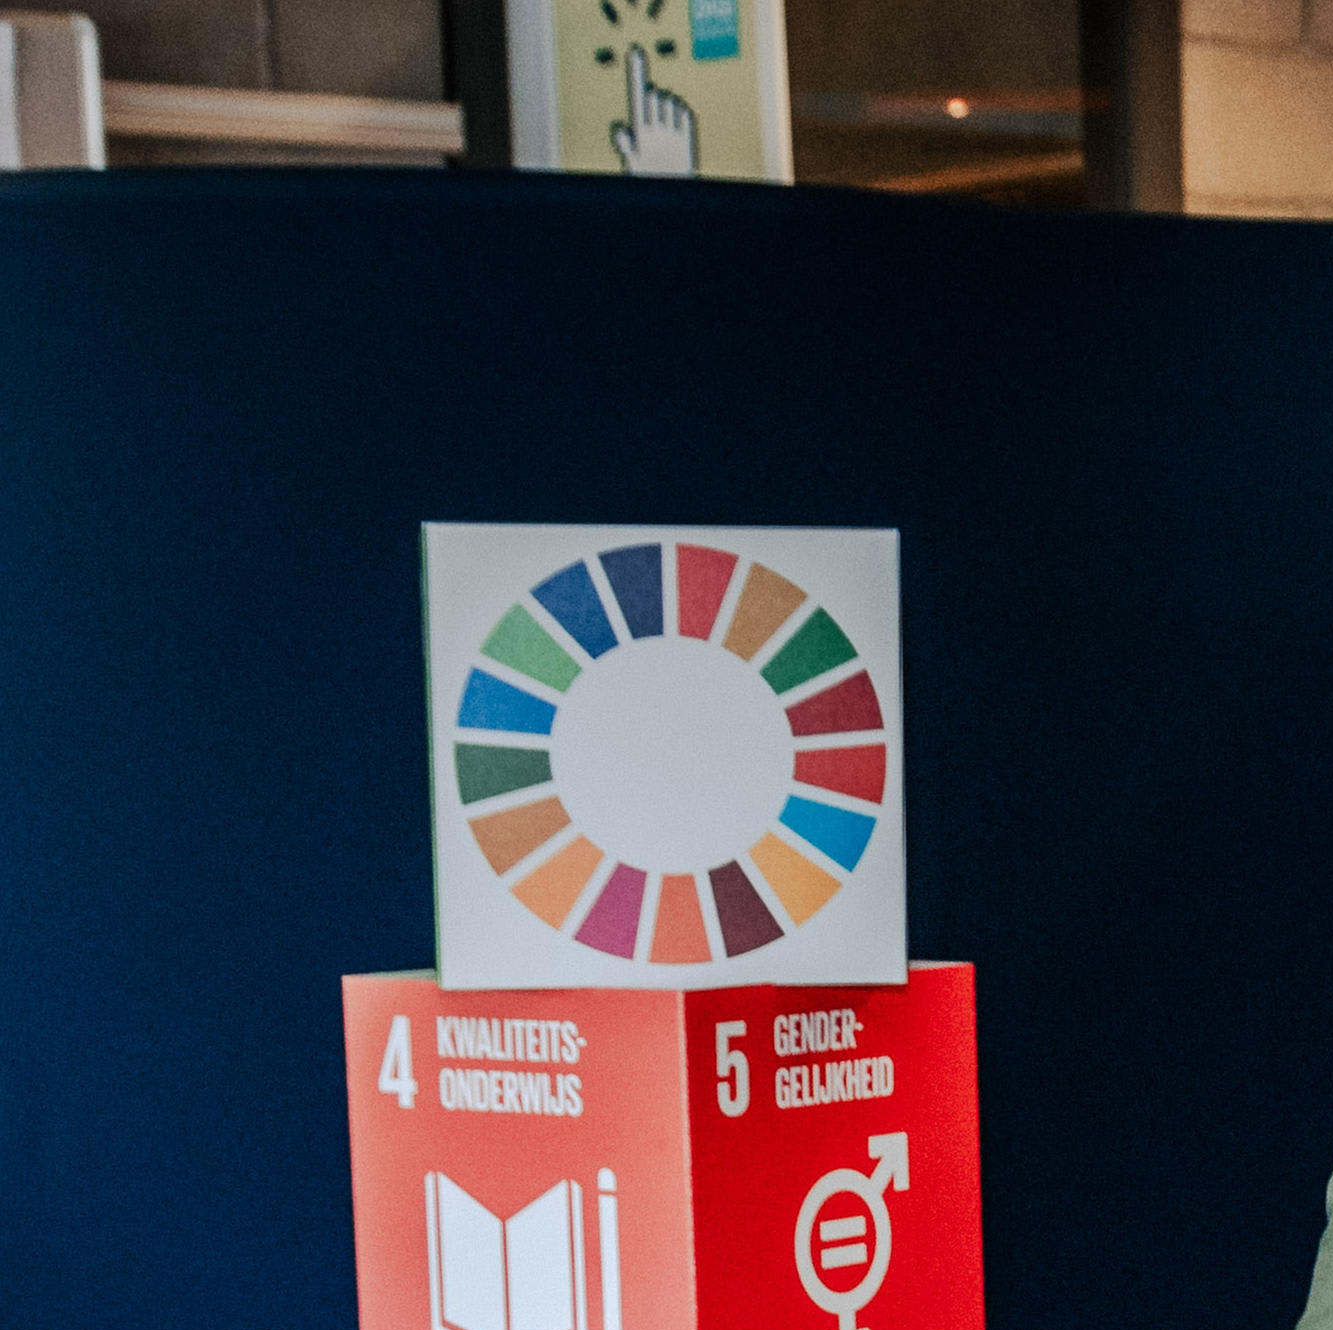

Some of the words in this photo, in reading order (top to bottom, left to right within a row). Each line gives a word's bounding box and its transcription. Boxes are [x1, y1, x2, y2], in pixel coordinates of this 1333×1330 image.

[436, 1017, 587, 1065] KWALITEITS-
[773, 1008, 864, 1057] GENDER-
[378, 1015, 417, 1109] 4
[715, 1020, 750, 1118] 5
[775, 1057, 894, 1109] GELIJKHEID
[439, 1069, 583, 1117] ONDERWIJS
